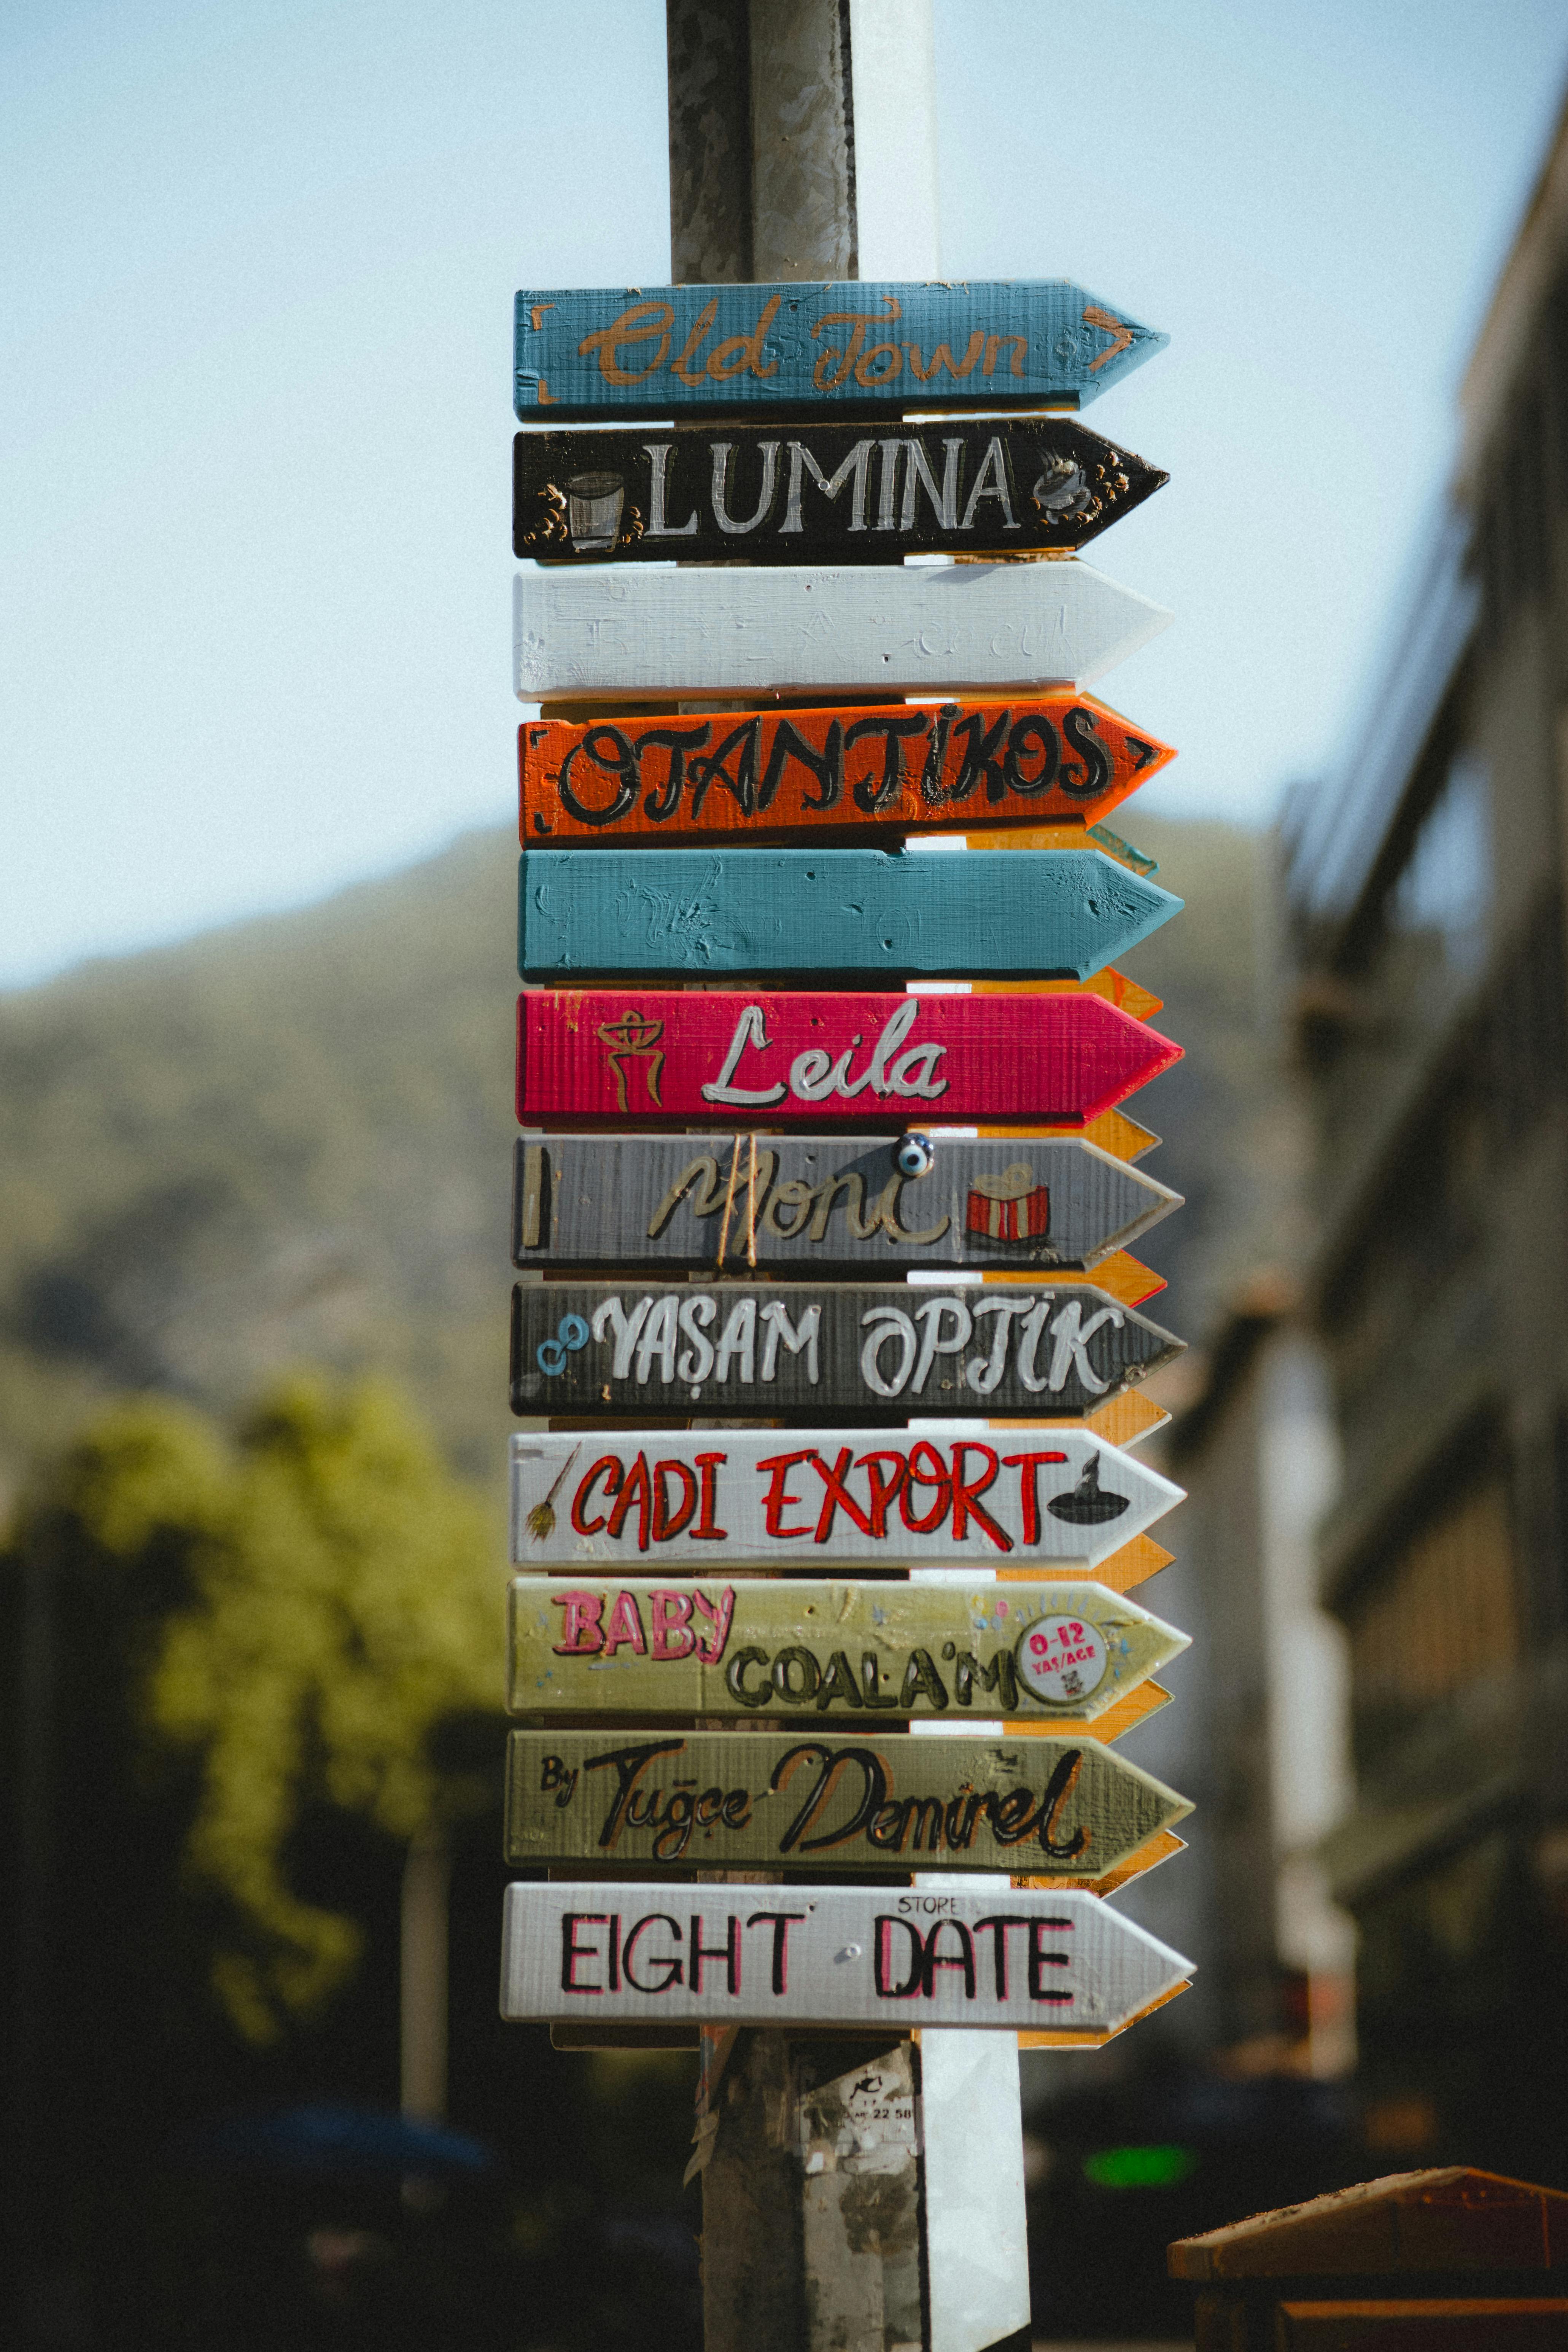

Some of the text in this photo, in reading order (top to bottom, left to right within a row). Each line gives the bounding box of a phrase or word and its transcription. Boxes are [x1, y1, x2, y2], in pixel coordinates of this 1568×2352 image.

[579, 294, 1027, 392] Old Town
[643, 437, 1019, 536] LUMINA
[701, 999, 949, 1108] Leila
[592, 1291, 1125, 1400] YAŞAM OPTİK
[571, 1441, 1069, 1553] CADI EXPORT
[553, 1585, 736, 1667] BABY
[1029, 1622, 1086, 1656] 0-12
[541, 1738, 1092, 1862] By Tuğçe Demirel
[898, 1896, 966, 1916] STORE
[561, 1913, 1075, 2007] EIGHT DATE
